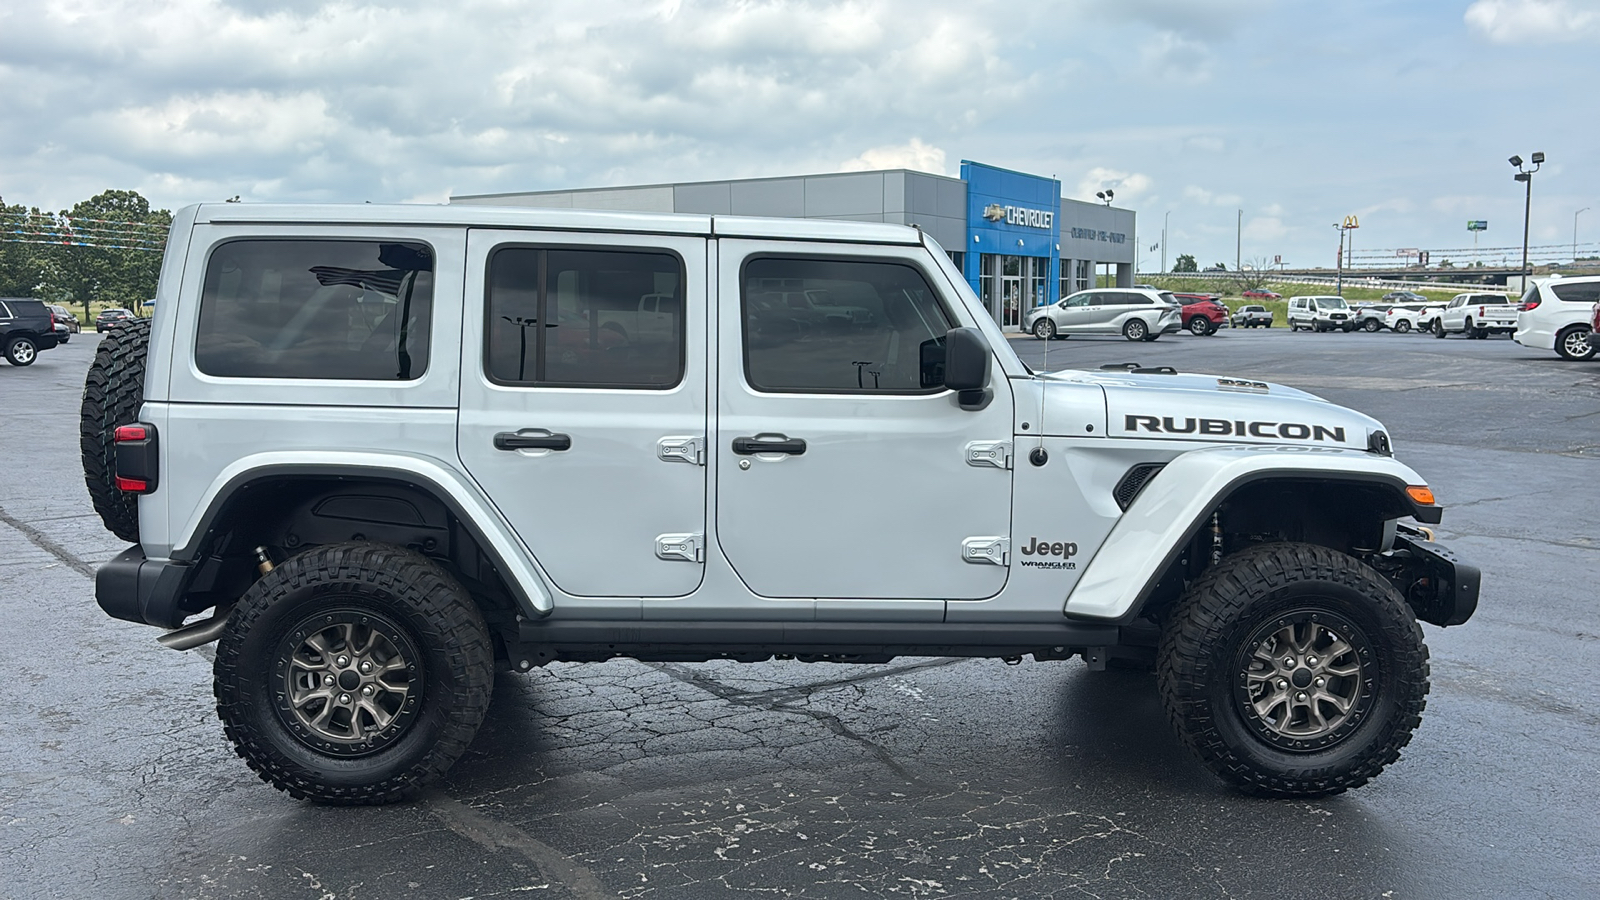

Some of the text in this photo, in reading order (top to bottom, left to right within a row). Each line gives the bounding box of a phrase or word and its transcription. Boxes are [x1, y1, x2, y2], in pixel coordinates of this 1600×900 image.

[1005, 205, 1054, 229] CHEVROLET
[1124, 414, 1346, 442] RUBICON
[1021, 537, 1078, 560] Jeep
[1020, 560, 1076, 568] WRANGLER
